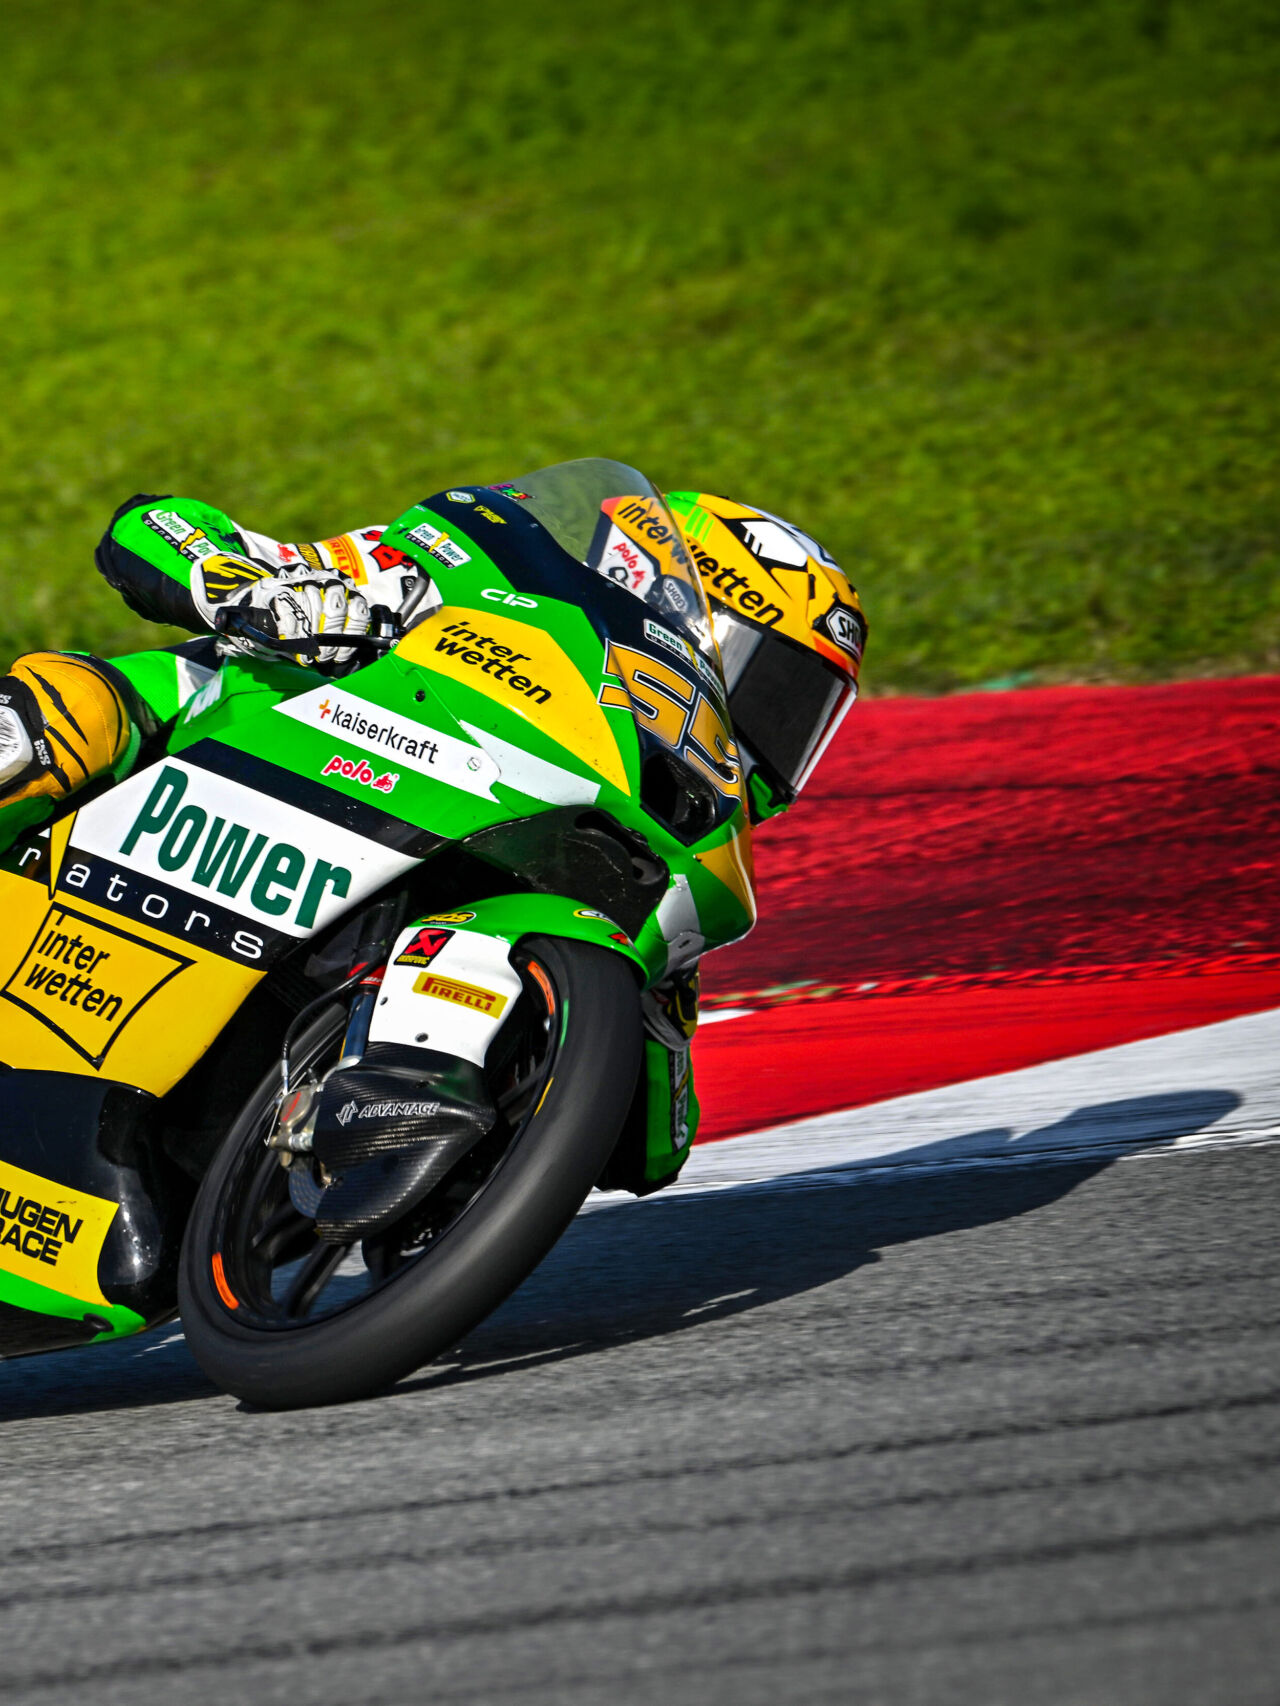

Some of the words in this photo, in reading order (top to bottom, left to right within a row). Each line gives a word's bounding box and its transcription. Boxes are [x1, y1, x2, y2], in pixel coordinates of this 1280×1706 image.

[156, 510, 187, 535] Green
[613, 542, 638, 569] polo
[480, 588, 539, 609] CIP
[441, 621, 533, 664] inter
[648, 623, 684, 652] Green
[434, 637, 552, 704] wetten
[331, 704, 439, 764] kaiserkraft
[322, 755, 374, 784] polo
[118, 764, 353, 930] Power
[37, 914, 111, 974] inter
[24, 963, 123, 1022] wetten
[421, 977, 497, 1012] PIRELLI
[358, 1102, 440, 1119] ADVANTAGE
